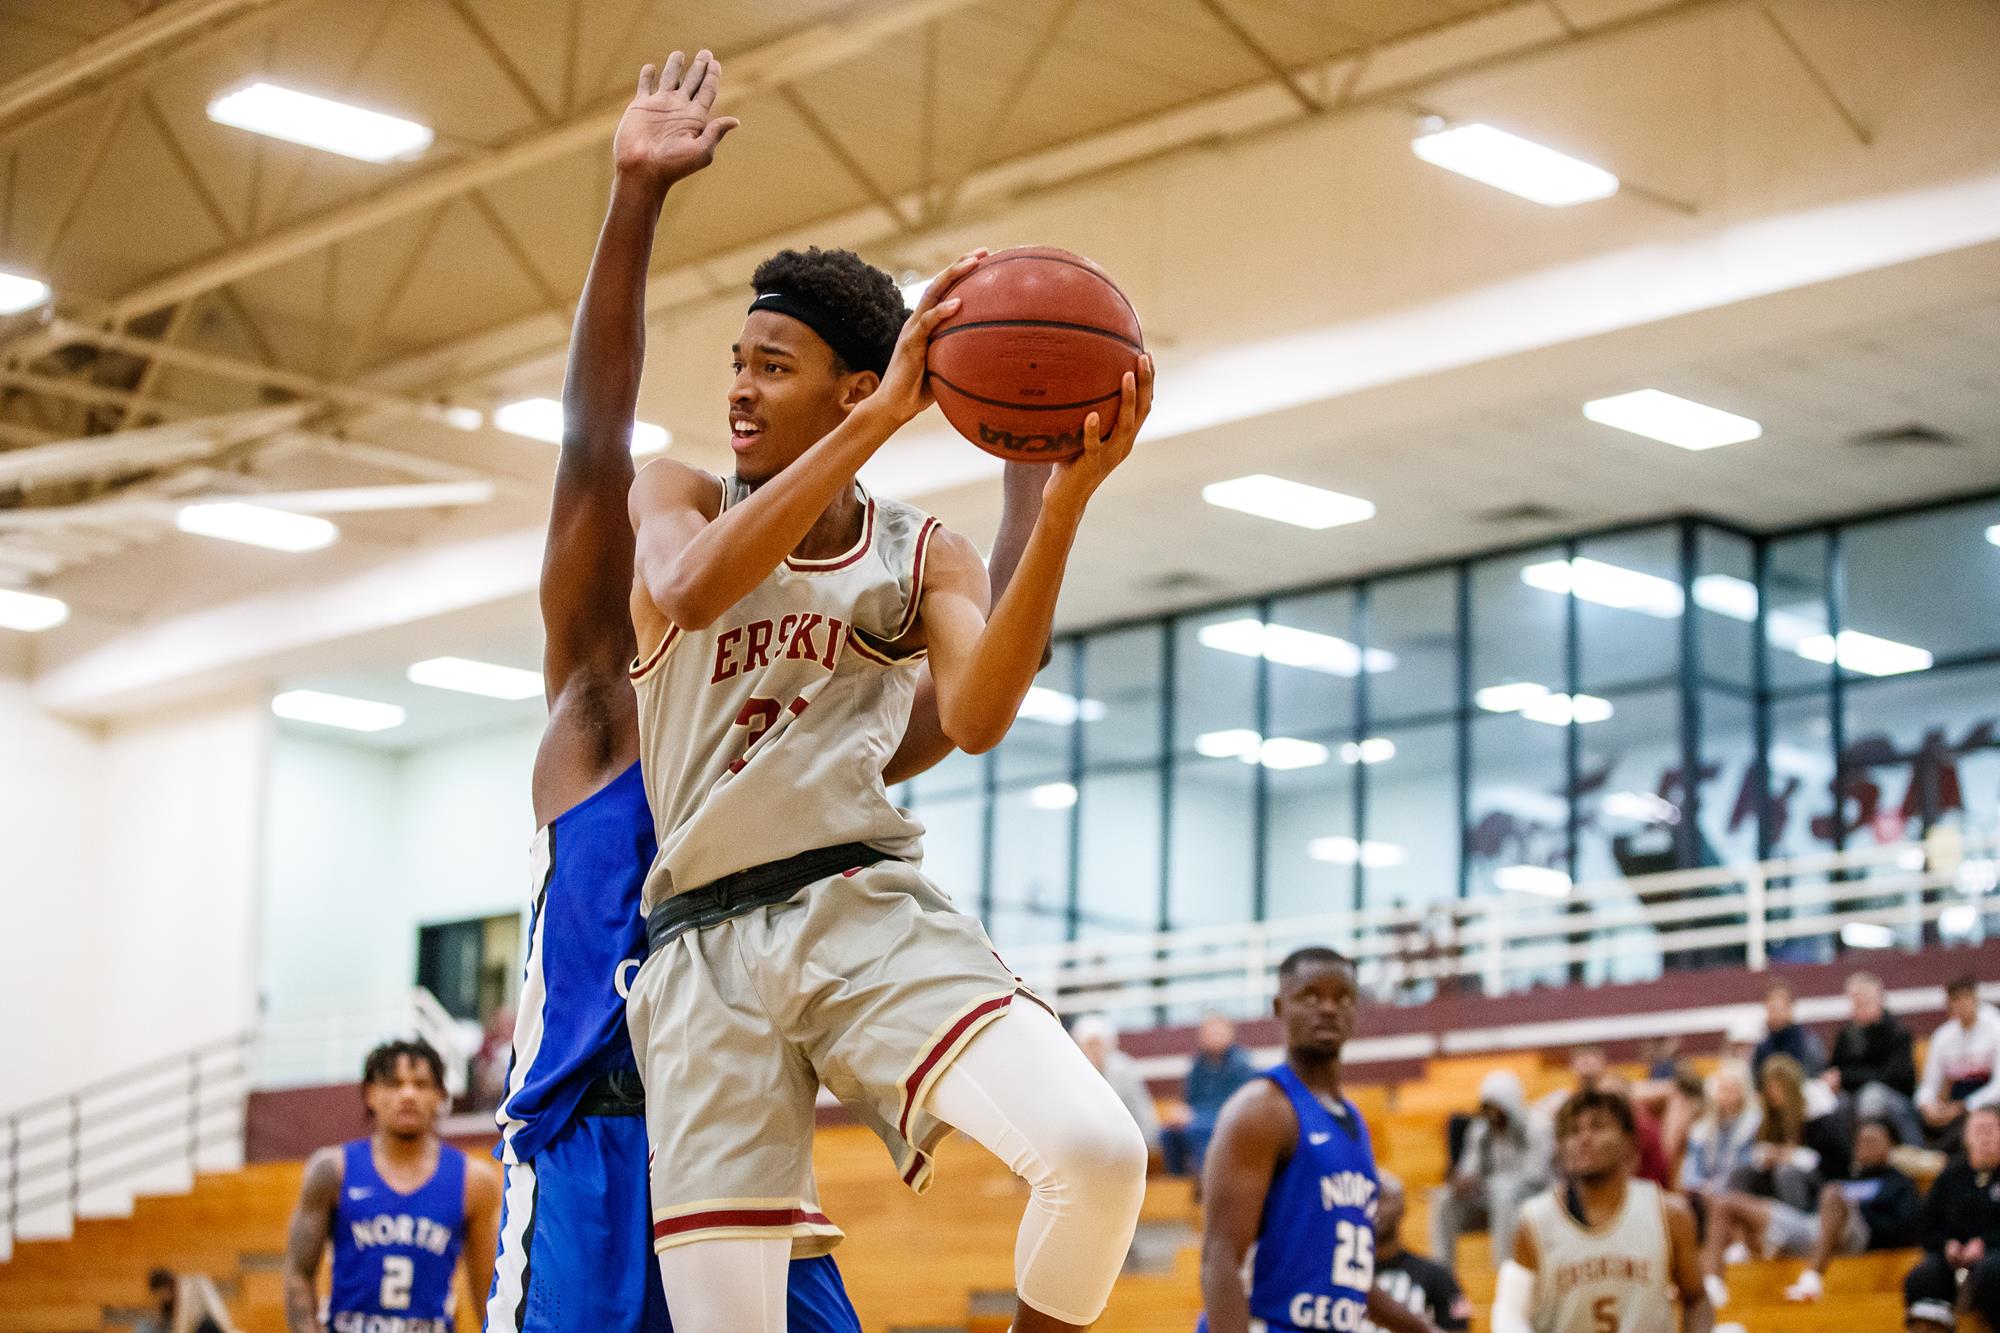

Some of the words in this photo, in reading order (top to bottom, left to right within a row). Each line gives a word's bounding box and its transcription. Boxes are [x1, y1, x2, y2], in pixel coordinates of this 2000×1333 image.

[711, 613, 852, 685] ERSKI
[351, 1214, 452, 1256] NORTH
[1332, 1220, 1375, 1292] 25
[379, 1255, 414, 1310] 2
